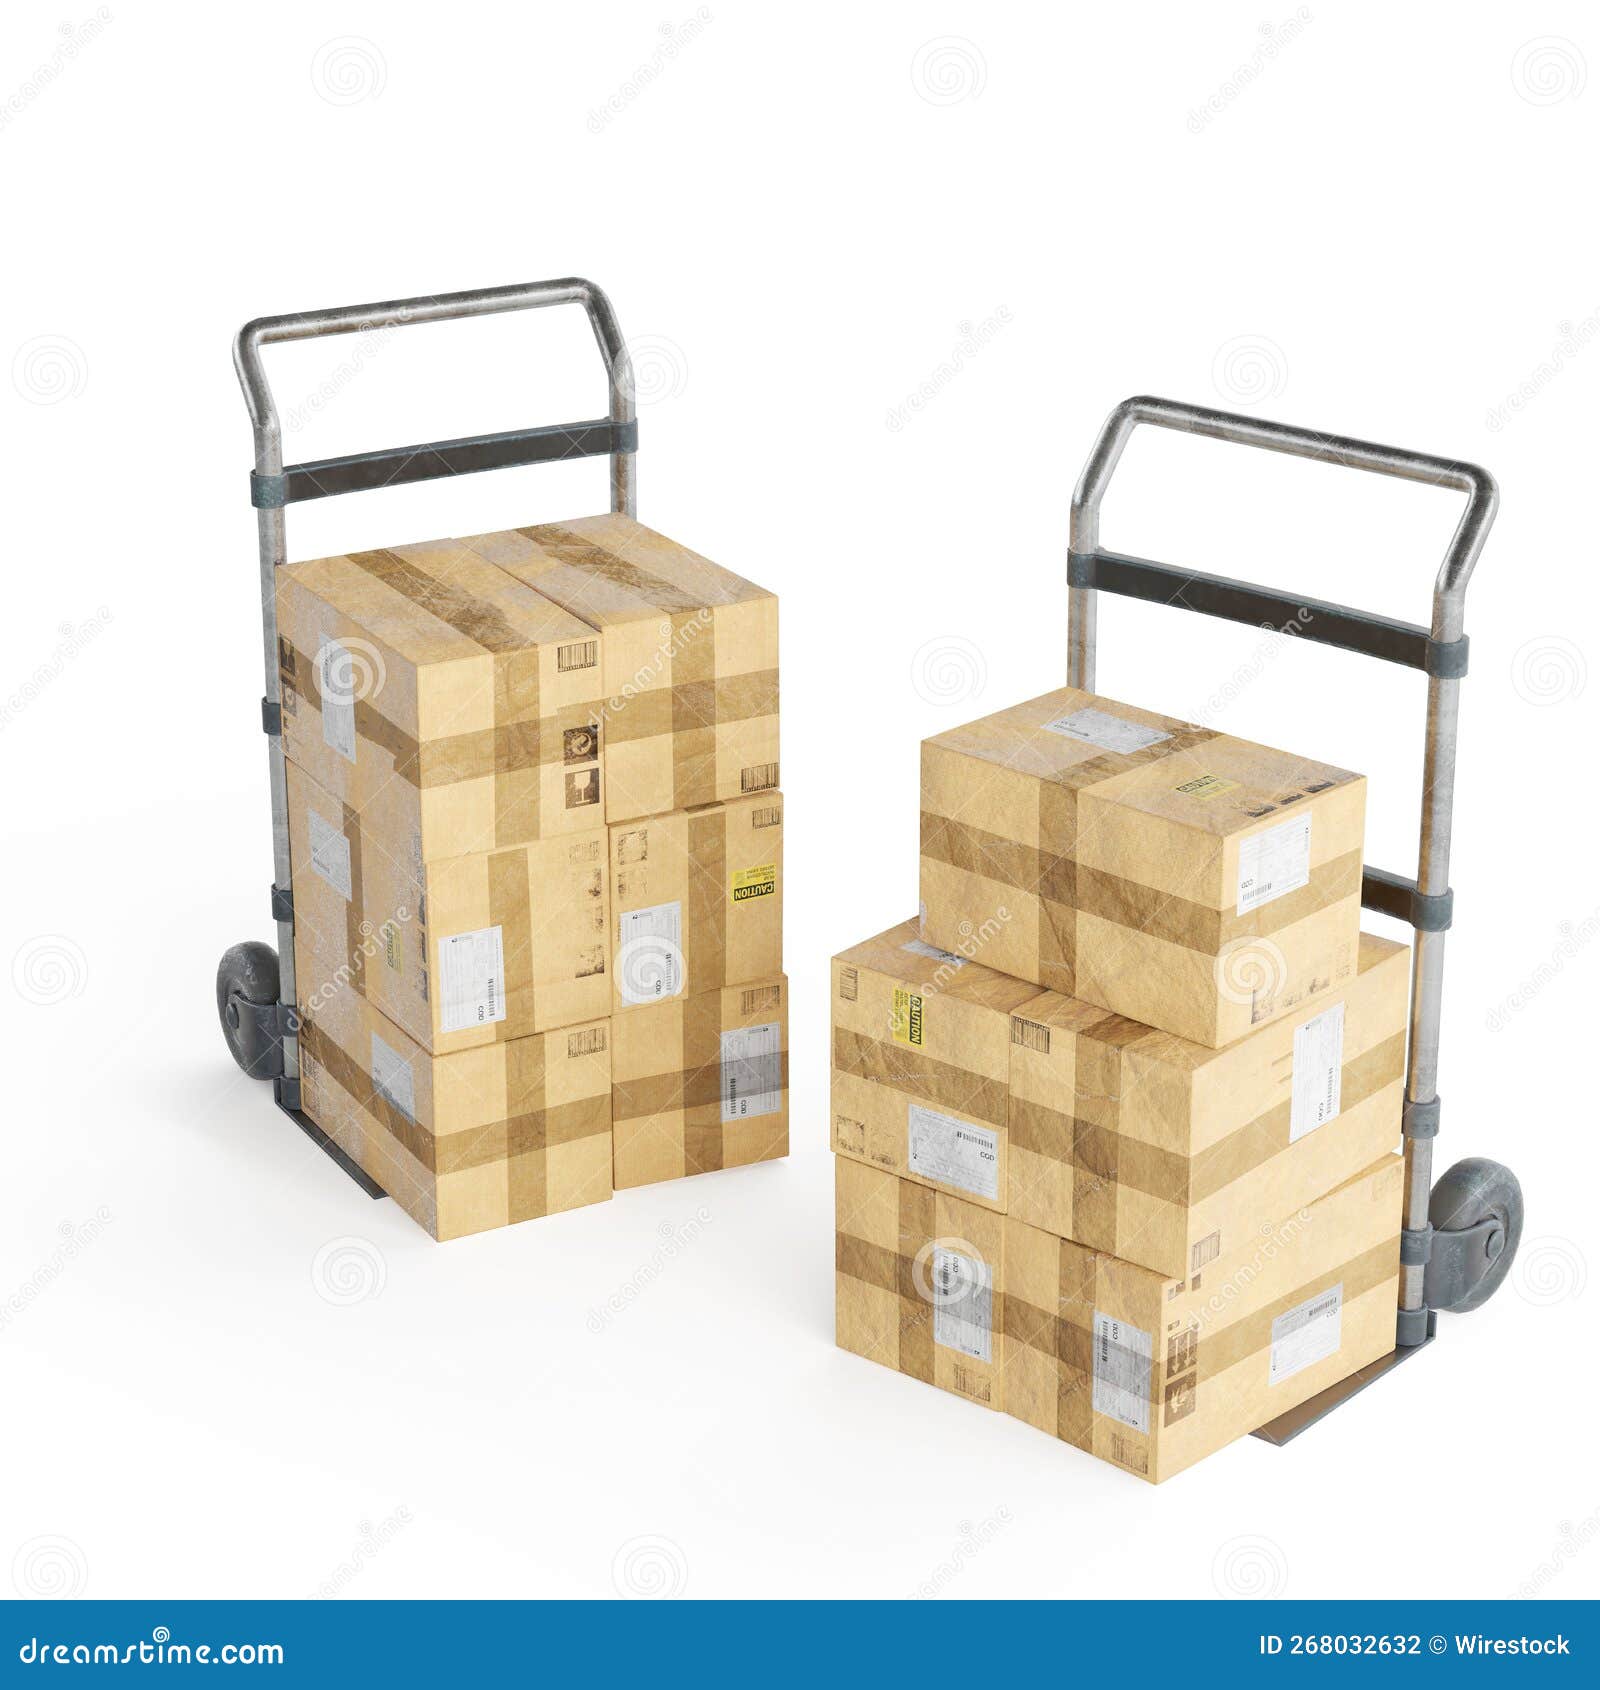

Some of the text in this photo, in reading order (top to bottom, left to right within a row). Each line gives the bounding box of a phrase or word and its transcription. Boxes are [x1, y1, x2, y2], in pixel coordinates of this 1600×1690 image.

[734, 882, 774, 900] CAUTION
[911, 996, 921, 1043] CAUTION
[980, 1151, 995, 1161] COD
